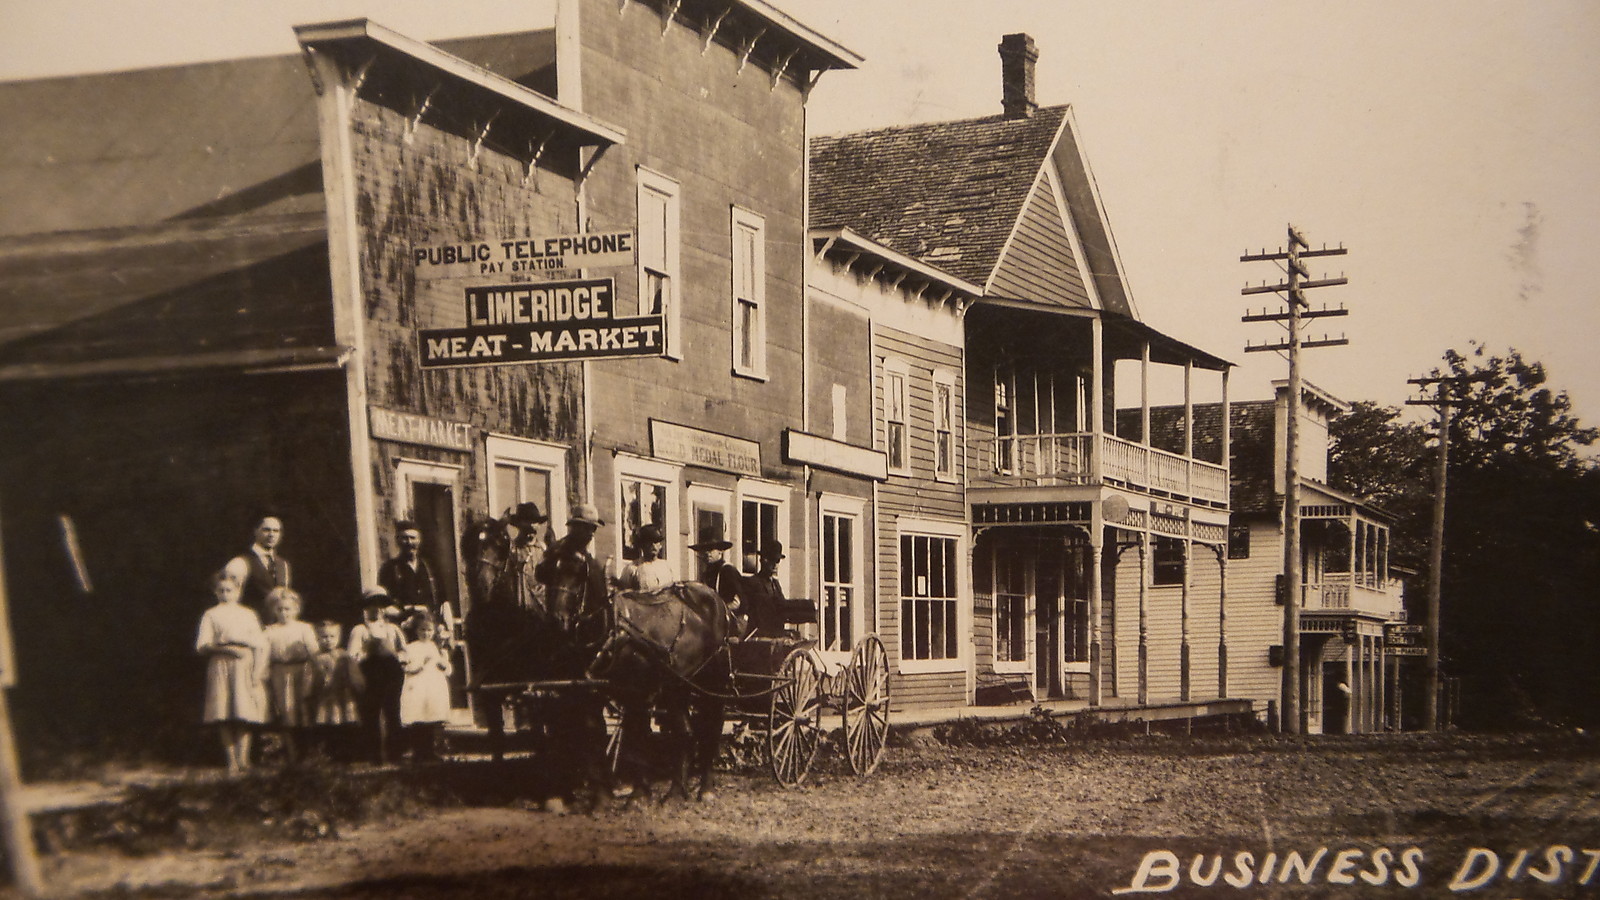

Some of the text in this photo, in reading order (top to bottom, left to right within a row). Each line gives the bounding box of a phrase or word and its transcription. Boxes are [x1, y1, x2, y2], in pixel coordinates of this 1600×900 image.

[415, 234, 632, 266] PUBLIC TELEPHONE
[480, 261, 504, 274] PAY
[469, 285, 609, 326] LIMERIDGE
[692, 446, 723, 467] MEDAL
[728, 453, 758, 473] FLOUR
